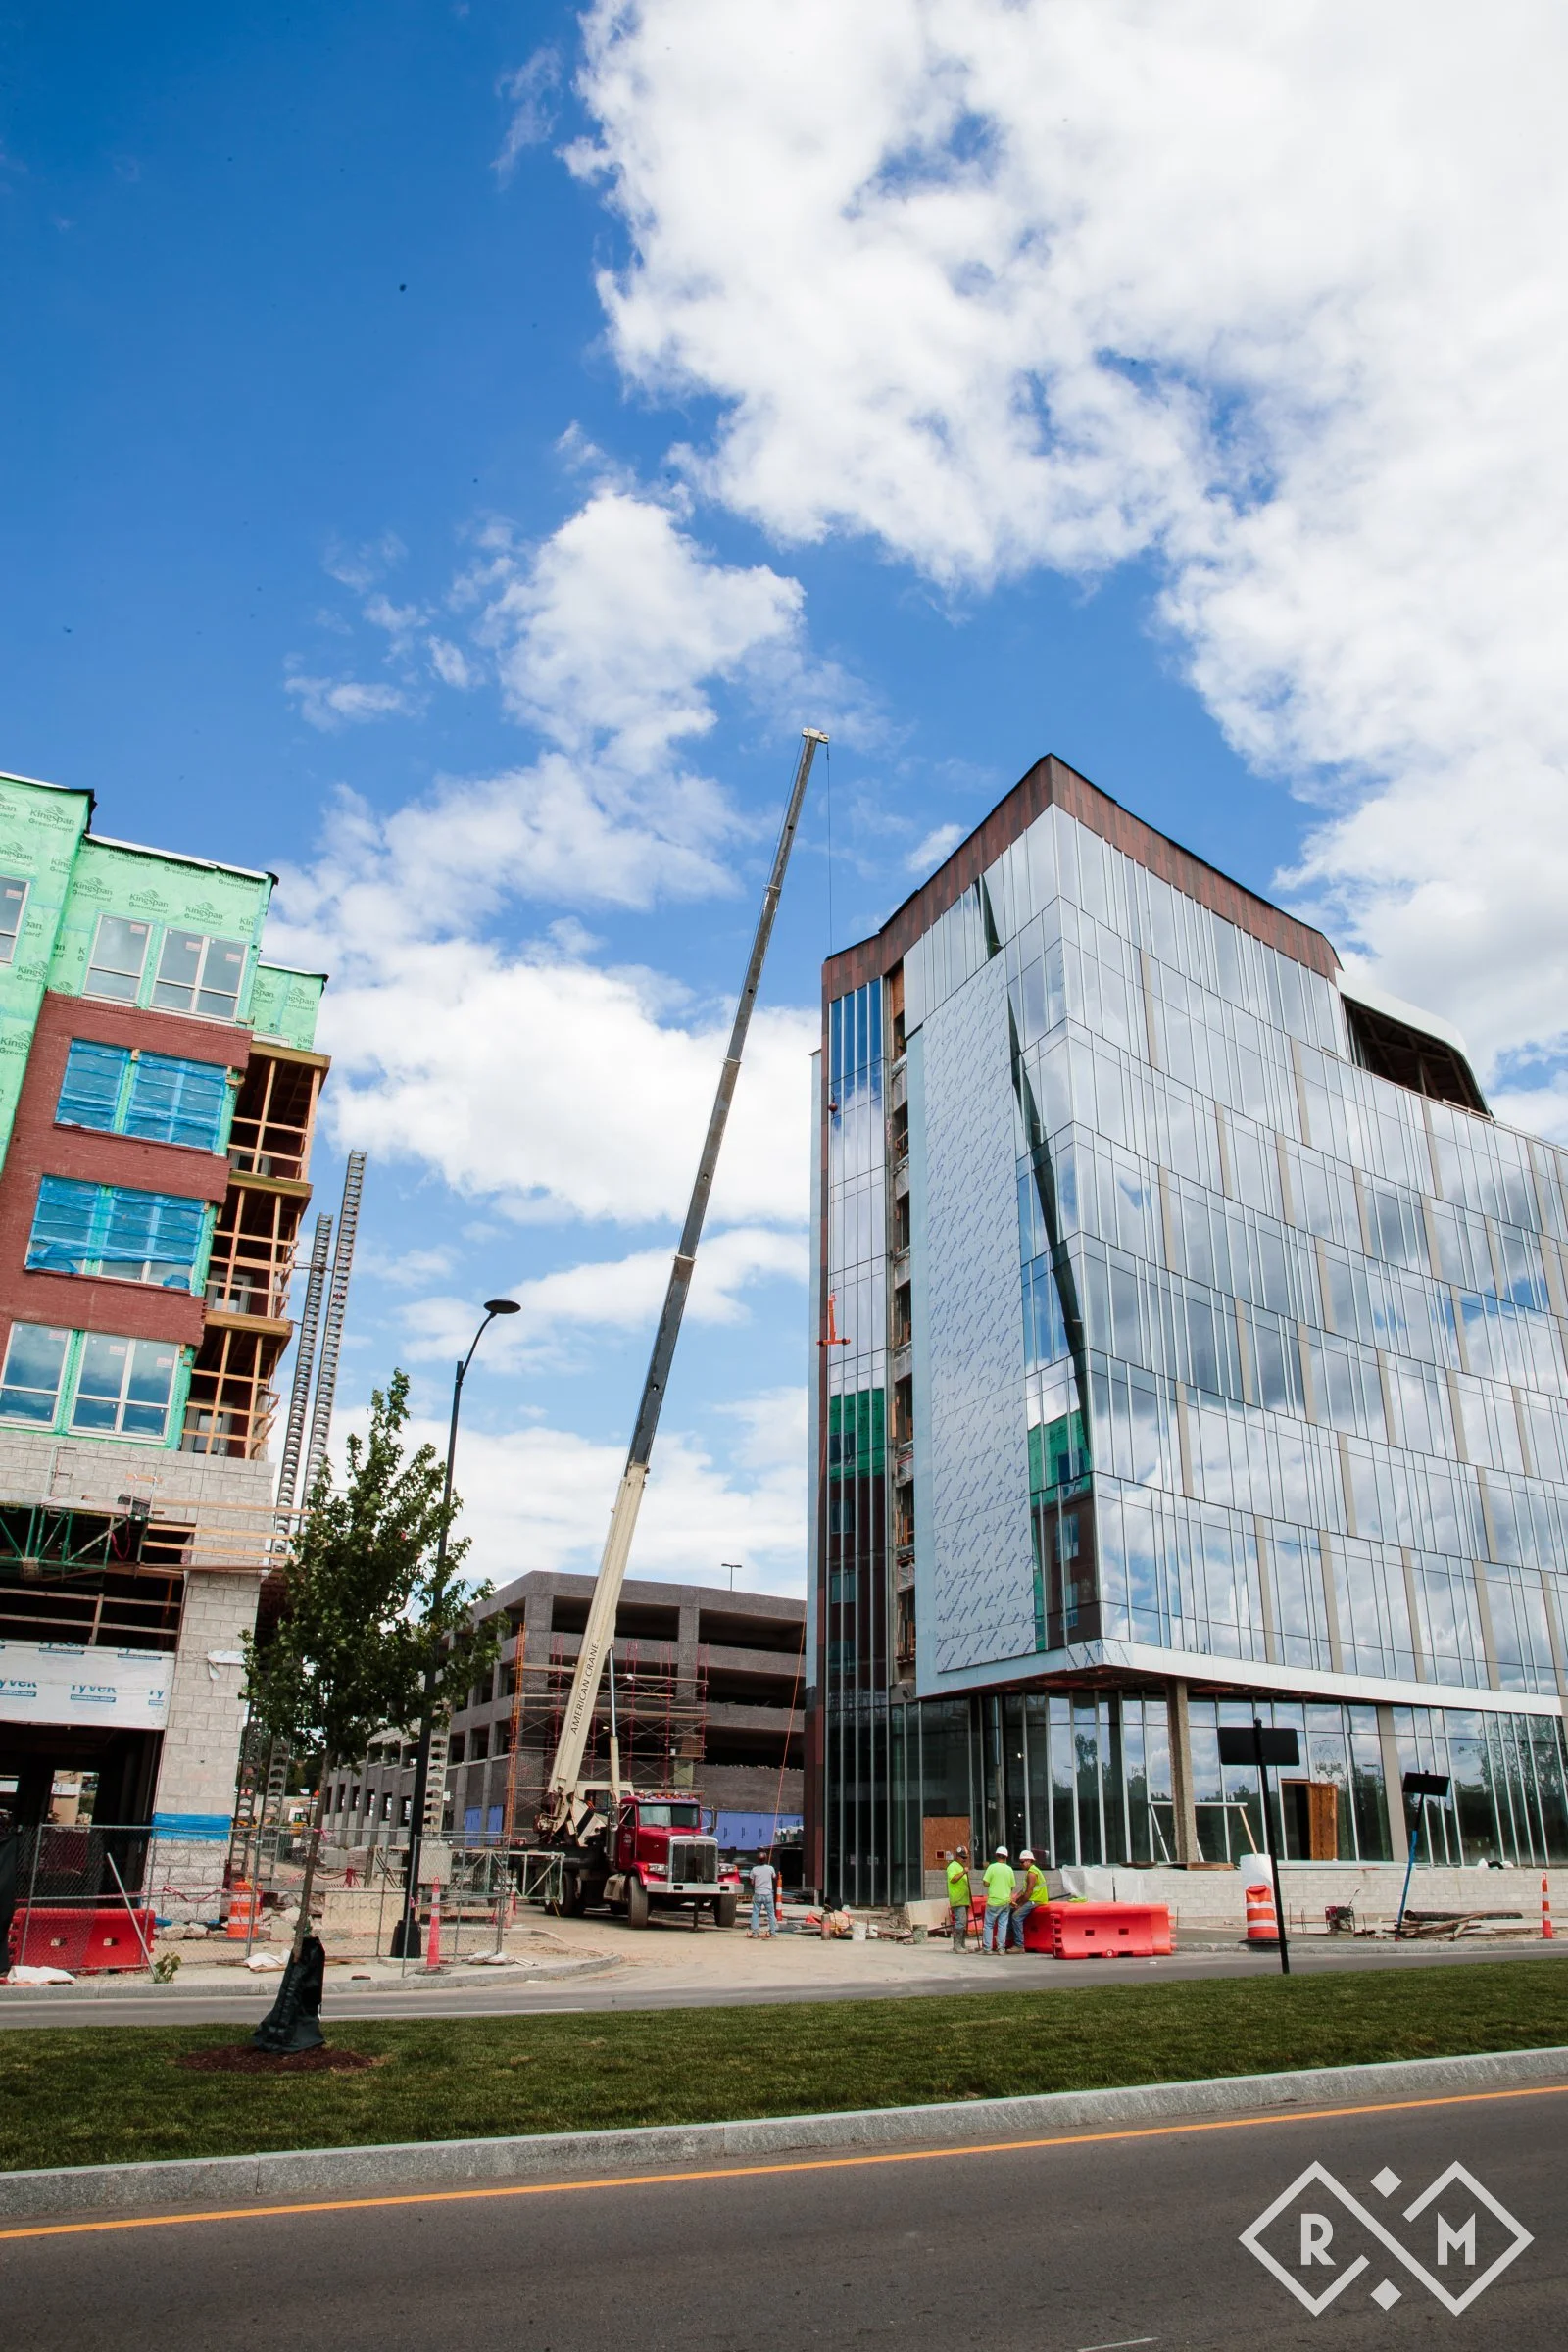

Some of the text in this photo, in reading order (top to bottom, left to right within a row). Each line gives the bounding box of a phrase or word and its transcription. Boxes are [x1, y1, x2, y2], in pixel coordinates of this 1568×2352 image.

[30, 808, 74, 825] Kingspan
[74, 881, 113, 896] Kingspan
[129, 893, 169, 908] Kingspan
[185, 905, 223, 920] Kingspan
[571, 1643, 599, 1735] AMERICAN CRANE
